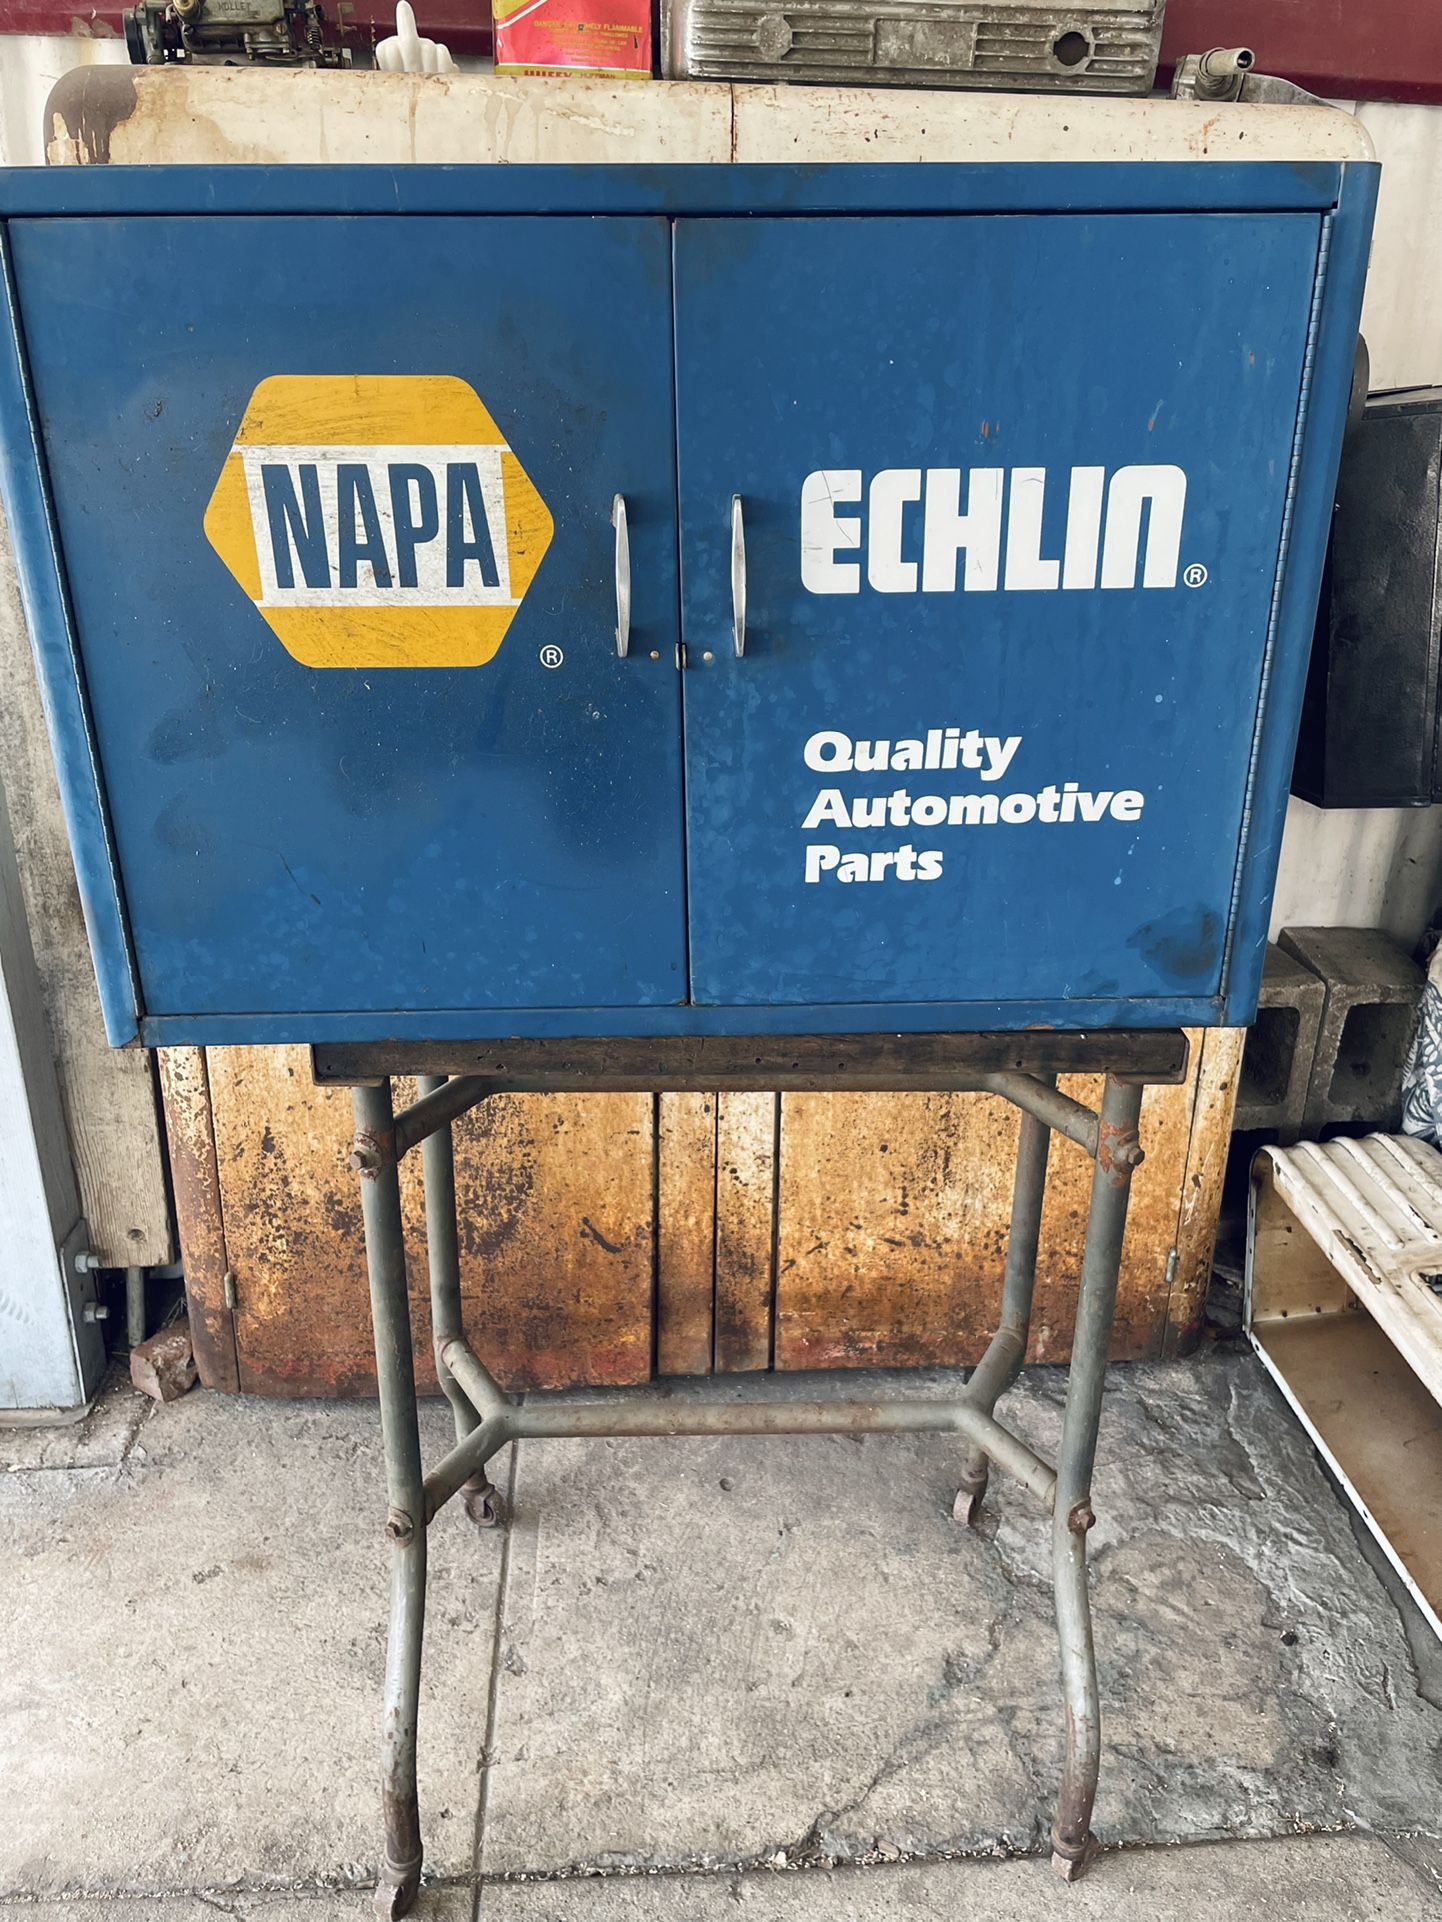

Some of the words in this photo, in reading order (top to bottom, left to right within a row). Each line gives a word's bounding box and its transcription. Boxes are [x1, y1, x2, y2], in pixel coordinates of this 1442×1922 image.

[261, 462, 500, 588] NAPA
[801, 465, 1187, 594] ECHLIN
[804, 728, 1022, 781] Quality
[801, 782, 1144, 829] Automotive
[804, 844, 943, 883] Parts
